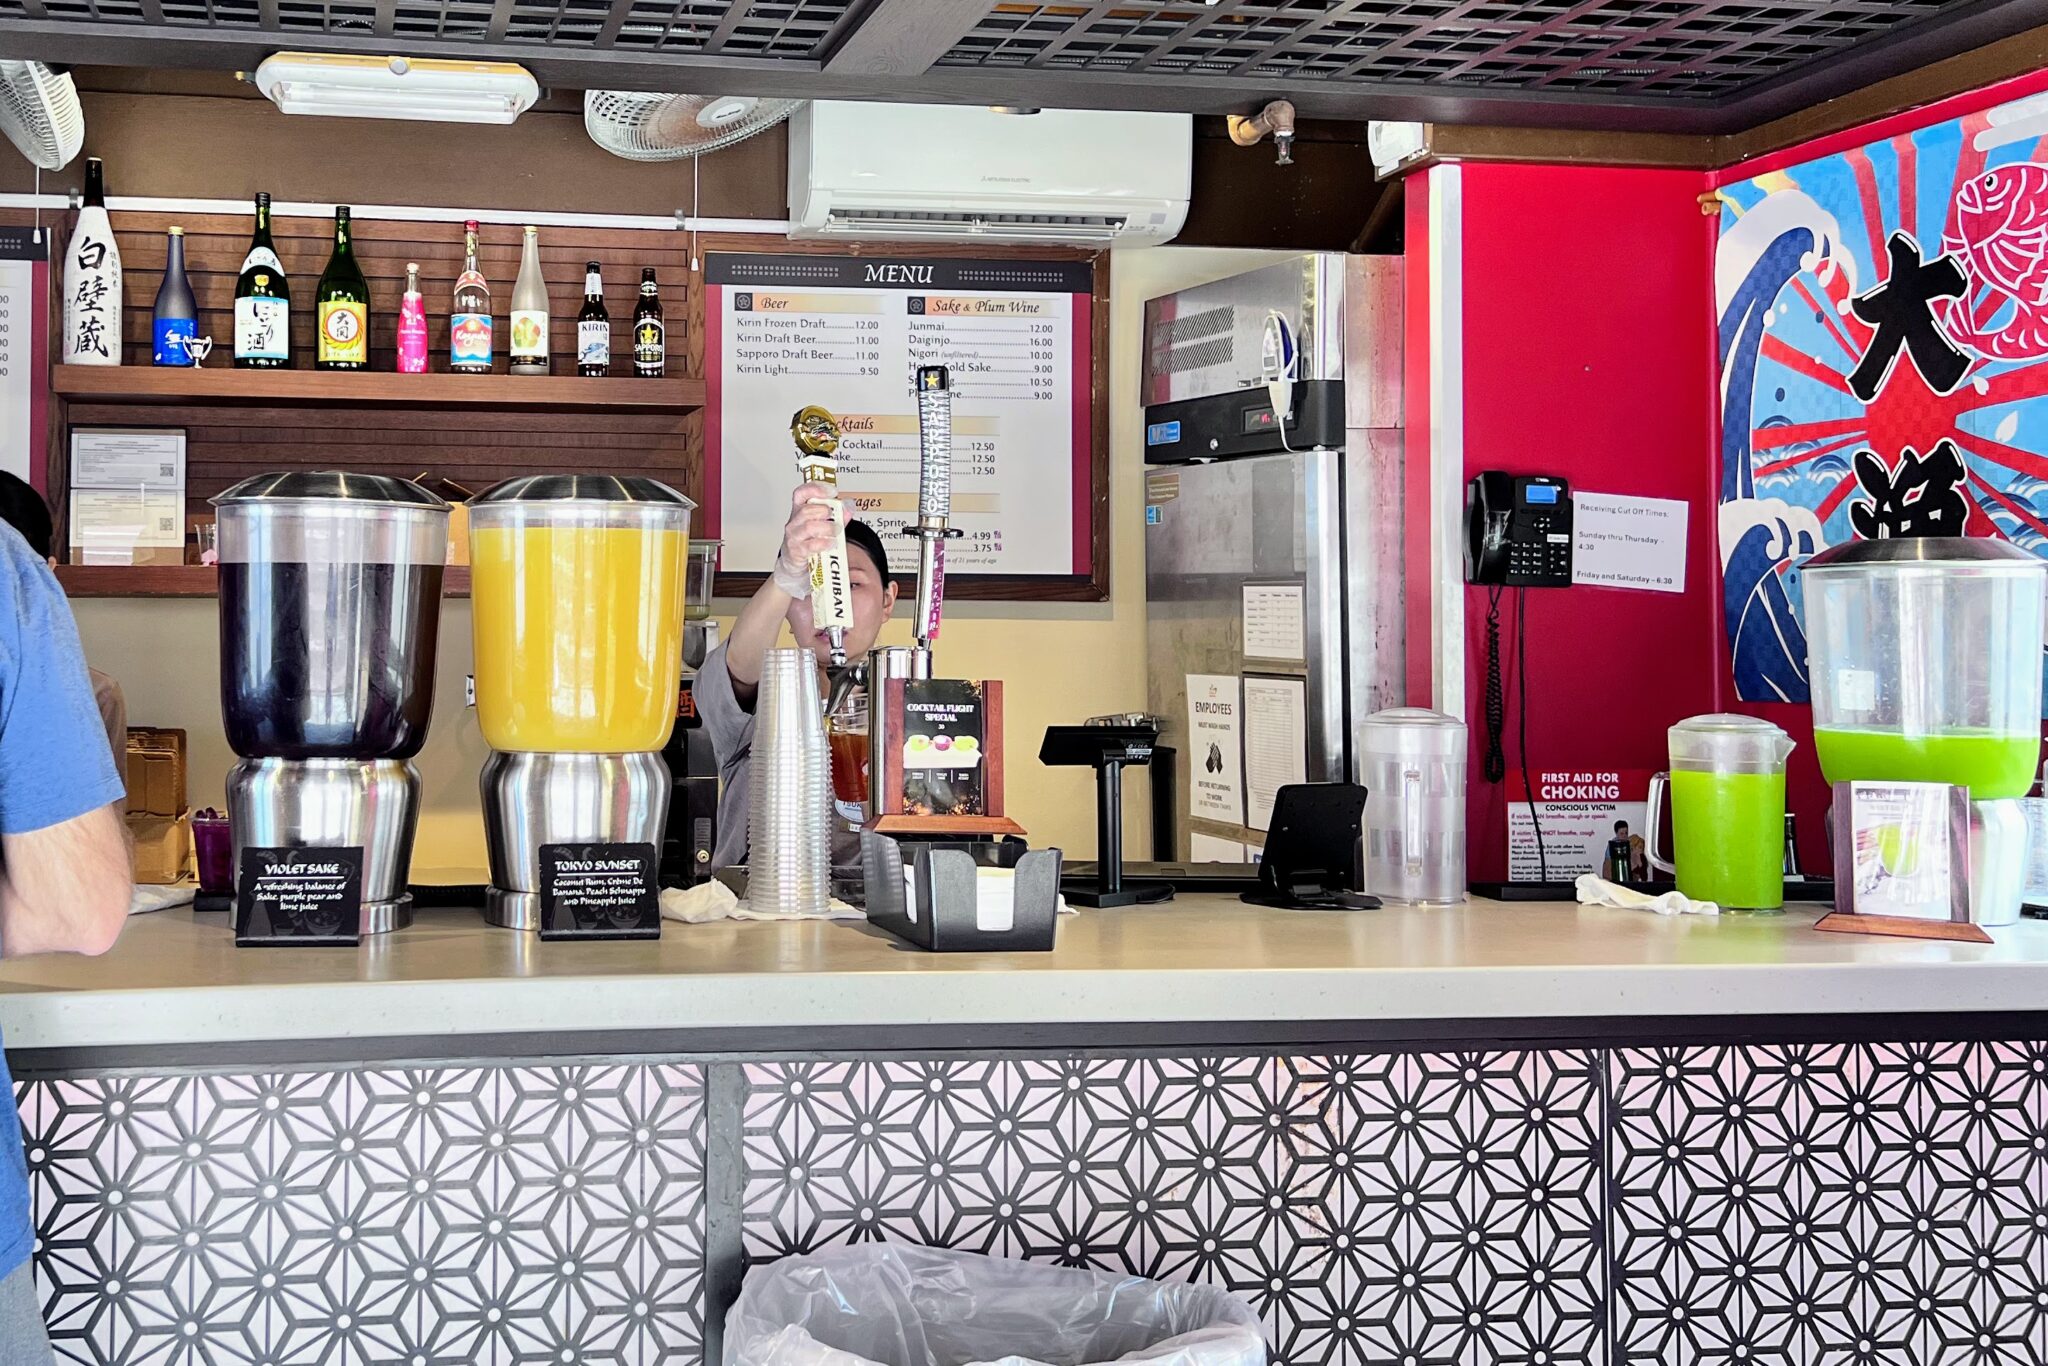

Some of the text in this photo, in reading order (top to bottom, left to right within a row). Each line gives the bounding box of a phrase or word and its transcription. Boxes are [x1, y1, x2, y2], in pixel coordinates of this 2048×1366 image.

[864, 264, 934, 283] MENU
[74, 236, 108, 358] 白壁蔵
[761, 297, 789, 309] Beer
[933, 299, 1040, 313] Sake & Plum Wine
[582, 324, 608, 332] KIRIN
[737, 318, 879, 330] Kirin Frozen Draft 12.00
[908, 321, 1053, 333] Junmai 12.00
[737, 333, 879, 345] Kirin Draft Beer 11.00
[908, 335, 1053, 347] Daiginjo 16.00
[634, 344, 663, 352] SAPPORO
[908, 348, 1053, 360] Nigori (unfiltered) 10.00
[737, 349, 879, 360] Sapporo Draft Beer 11.00
[737, 364, 879, 376] Kirin Light 9.50
[968, 363, 991, 372] Sake
[1034, 365, 1053, 373] 9.00
[1030, 378, 1053, 386] 10.50
[1034, 392, 1053, 400] 9.00
[837, 416, 874, 434] cktails
[842, 439, 882, 449] Cocktail
[971, 442, 995, 451] 12.50
[834, 451, 995, 463] ake 12.50
[927, 394, 940, 513] SAPPORO
[972, 467, 995, 475] 12.50
[1580, 504, 1616, 514] Receiving
[1645, 508, 1669, 517] Times:
[877, 517, 909, 528] Sprite,
[972, 532, 990, 540] 4.99
[1579, 531, 1606, 541] Sunday
[1625, 535, 1658, 545] Thursday
[974, 544, 991, 552] 3.75
[1577, 571, 1599, 580] Friday
[1617, 574, 1650, 584] Saturday
[829, 555, 844, 618] ICHIBAN
[907, 704, 974, 712] COCKTAIL FLIGHT
[1195, 701, 1232, 715] EMPLOYEES
[925, 713, 957, 722] SPECIAL
[1541, 773, 1619, 783] FIRST AID FOR
[1541, 785, 1620, 799] CHOKING
[264, 863, 340, 875] VIOLET SAKE
[555, 860, 640, 871] TOKYO SUNSET
[254, 882, 347, 892] A refreshing balance of
[554, 878, 584, 887] Coconut
[585, 878, 606, 886] Rum,
[280, 892, 306, 902] purple
[307, 893, 325, 902] pear
[586, 887, 608, 895] Peach
[609, 887, 646, 896] Schnapps
[300, 903, 319, 912] juice
[580, 897, 616, 906] Pineapple
